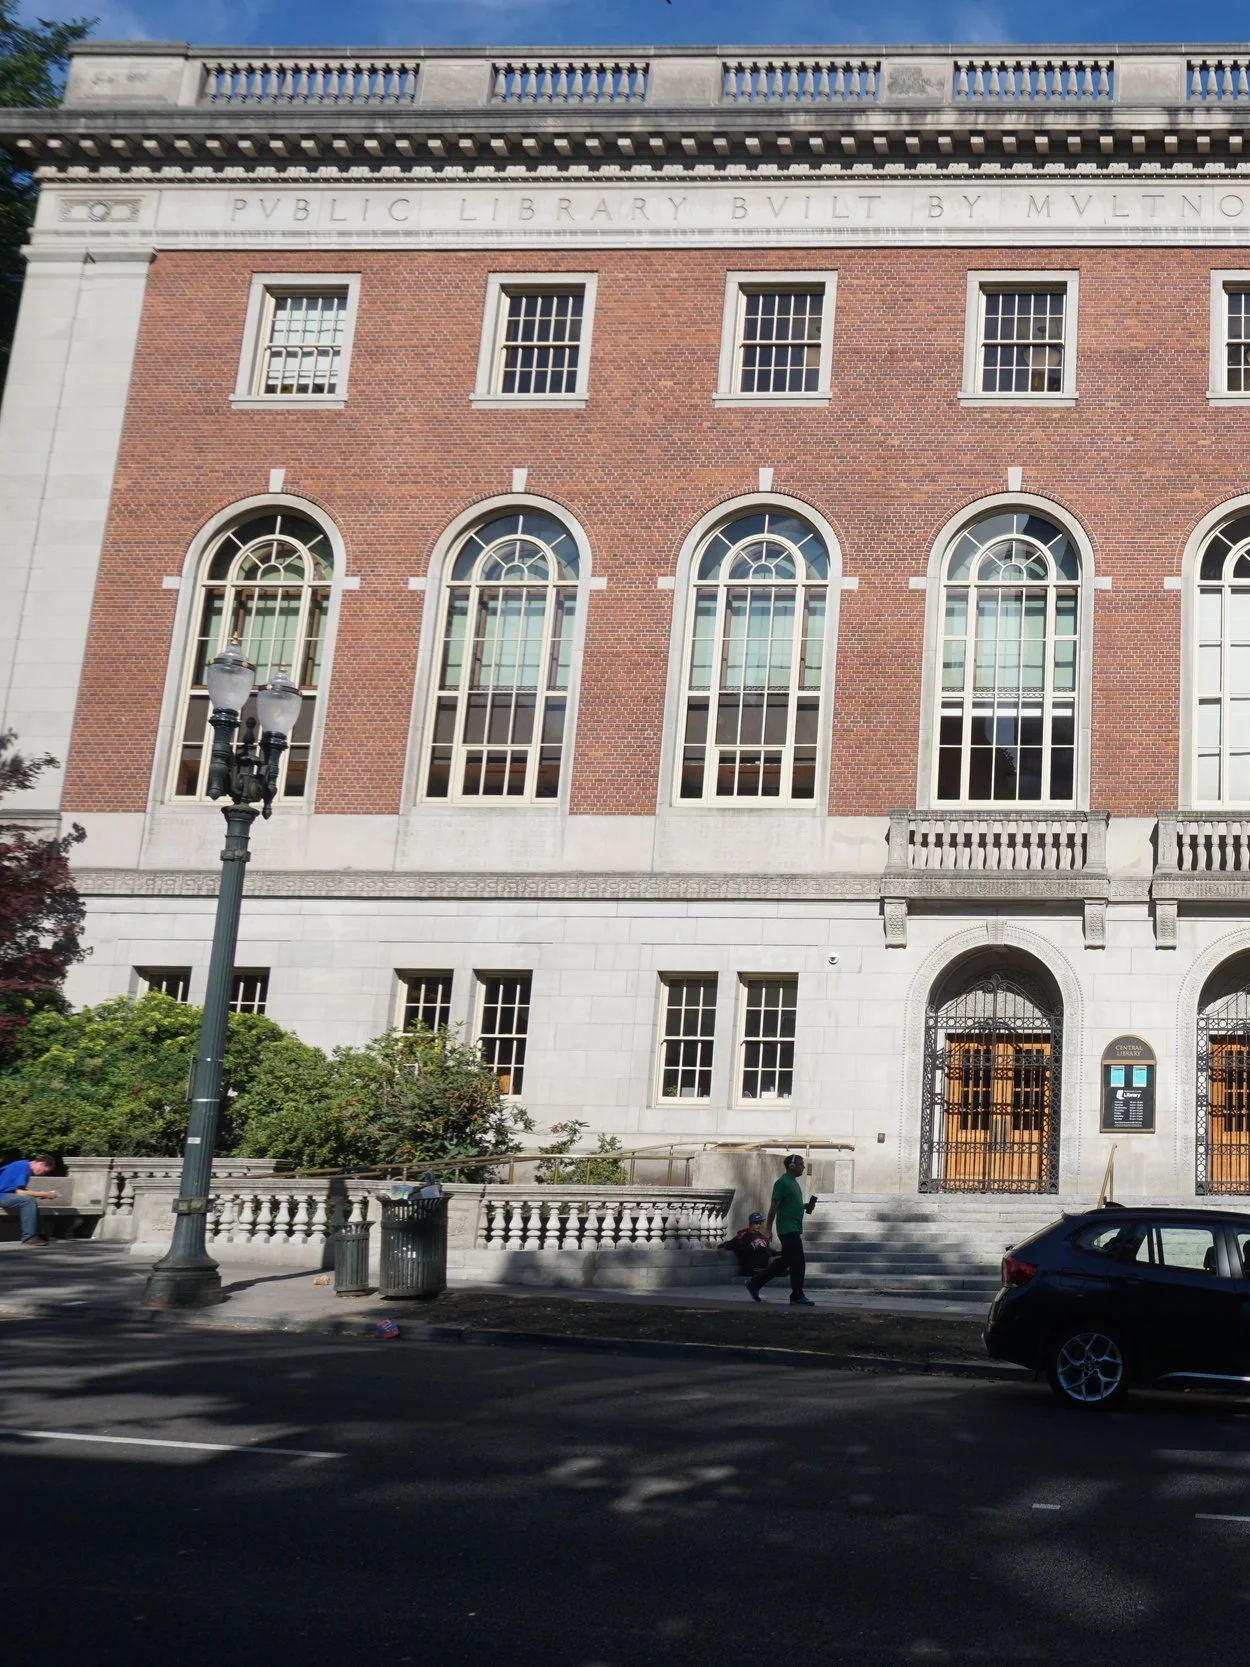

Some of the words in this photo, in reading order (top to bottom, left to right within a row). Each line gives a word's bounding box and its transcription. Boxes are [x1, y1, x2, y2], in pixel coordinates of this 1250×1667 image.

[229, 197, 411, 223] PVBLIC
[458, 196, 688, 223] LIBRARY
[731, 194, 883, 221] BVILT
[926, 194, 984, 219] BY
